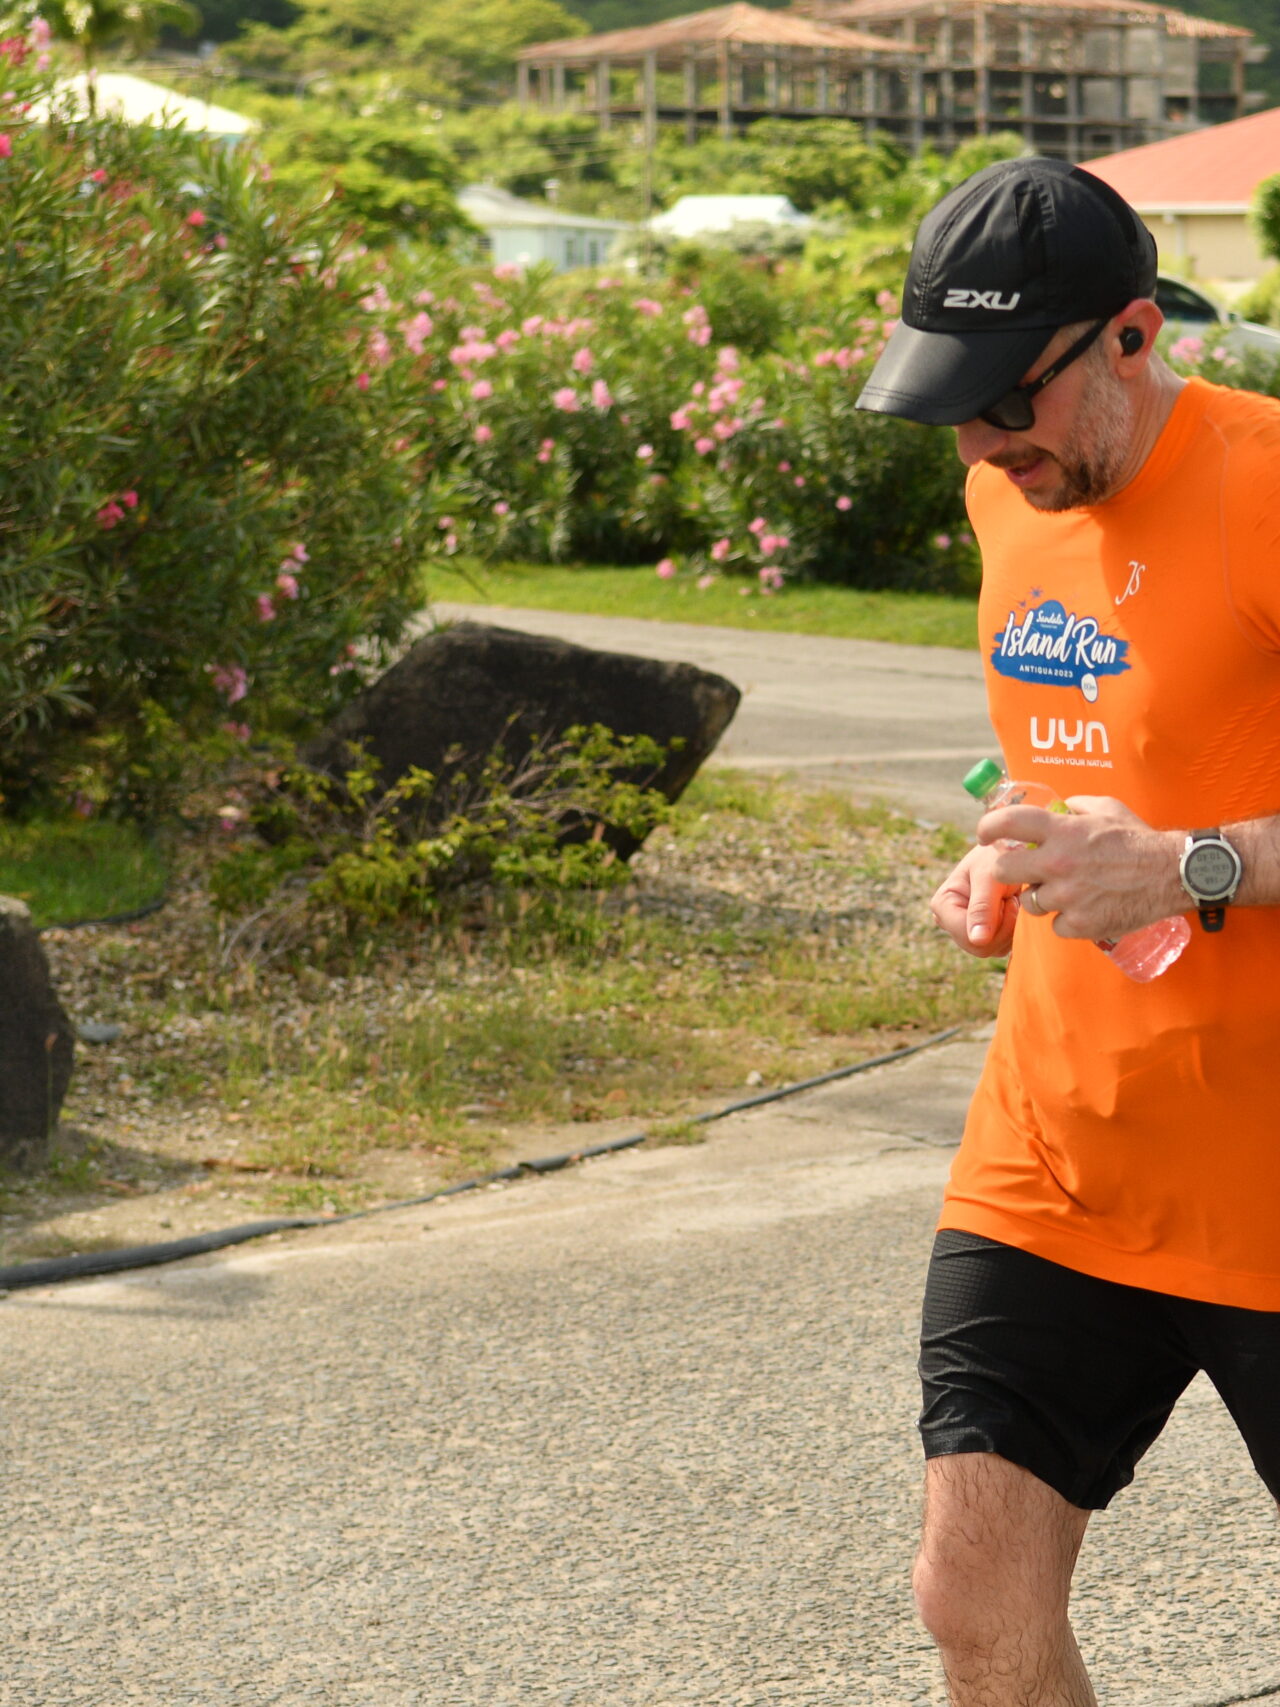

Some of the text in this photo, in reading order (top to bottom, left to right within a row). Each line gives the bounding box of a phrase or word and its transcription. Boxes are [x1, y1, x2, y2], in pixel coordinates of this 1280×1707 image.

[943, 289, 1020, 311] 2XU
[1001, 611, 1117, 669] Island Run
[1019, 665, 1074, 678] ANTIGUA 2023
[1032, 755, 1113, 769] UNLEASH YOUR NATURE
